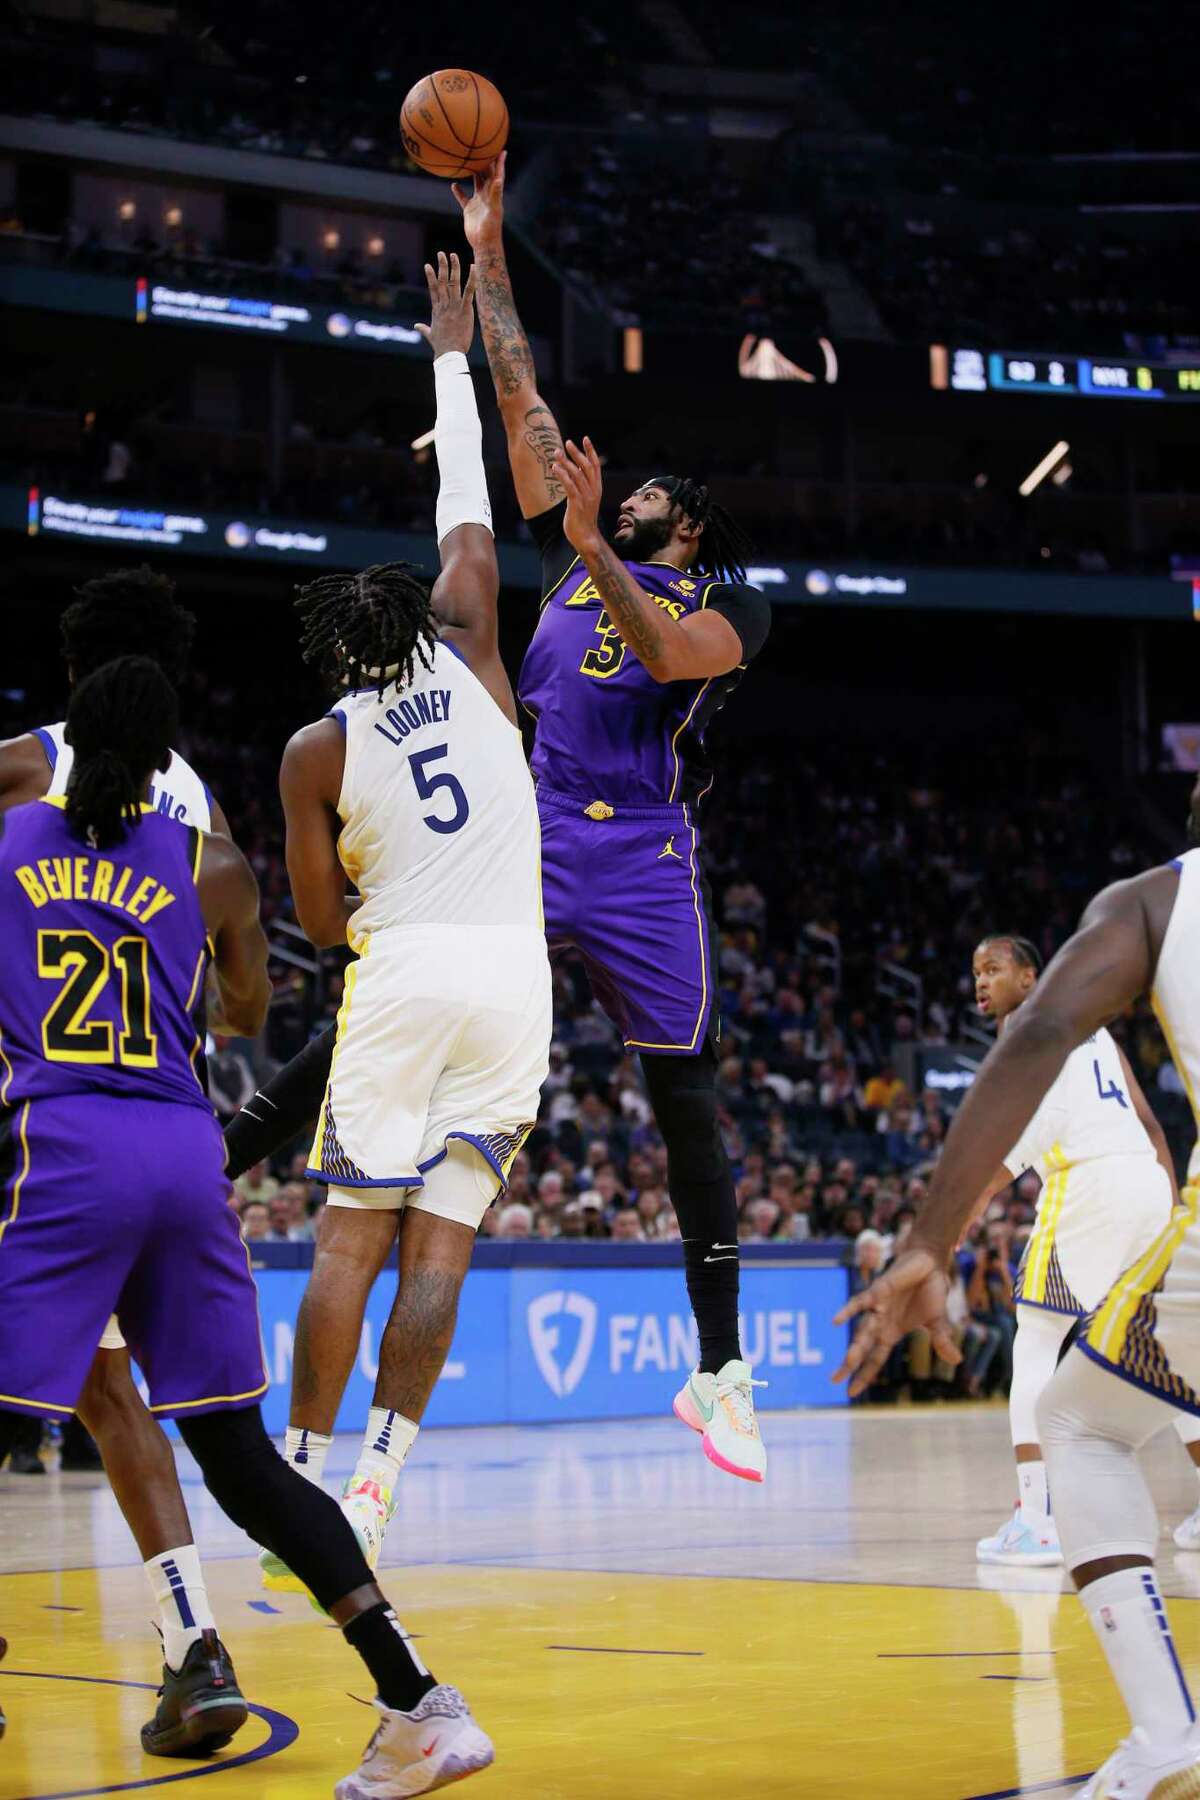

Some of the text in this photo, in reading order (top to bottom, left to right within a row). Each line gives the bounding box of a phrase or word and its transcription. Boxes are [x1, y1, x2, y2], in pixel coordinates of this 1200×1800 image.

[668, 581, 696, 598] bibigo
[579, 608, 628, 679] 3
[374, 689, 452, 747] LOONEY
[407, 742, 470, 835] 5
[15, 855, 176, 924] BEVERLEY
[37, 928, 159, 1068] 21
[1093, 1059, 1129, 1109] 4
[608, 1310, 823, 1374] FANUEL
